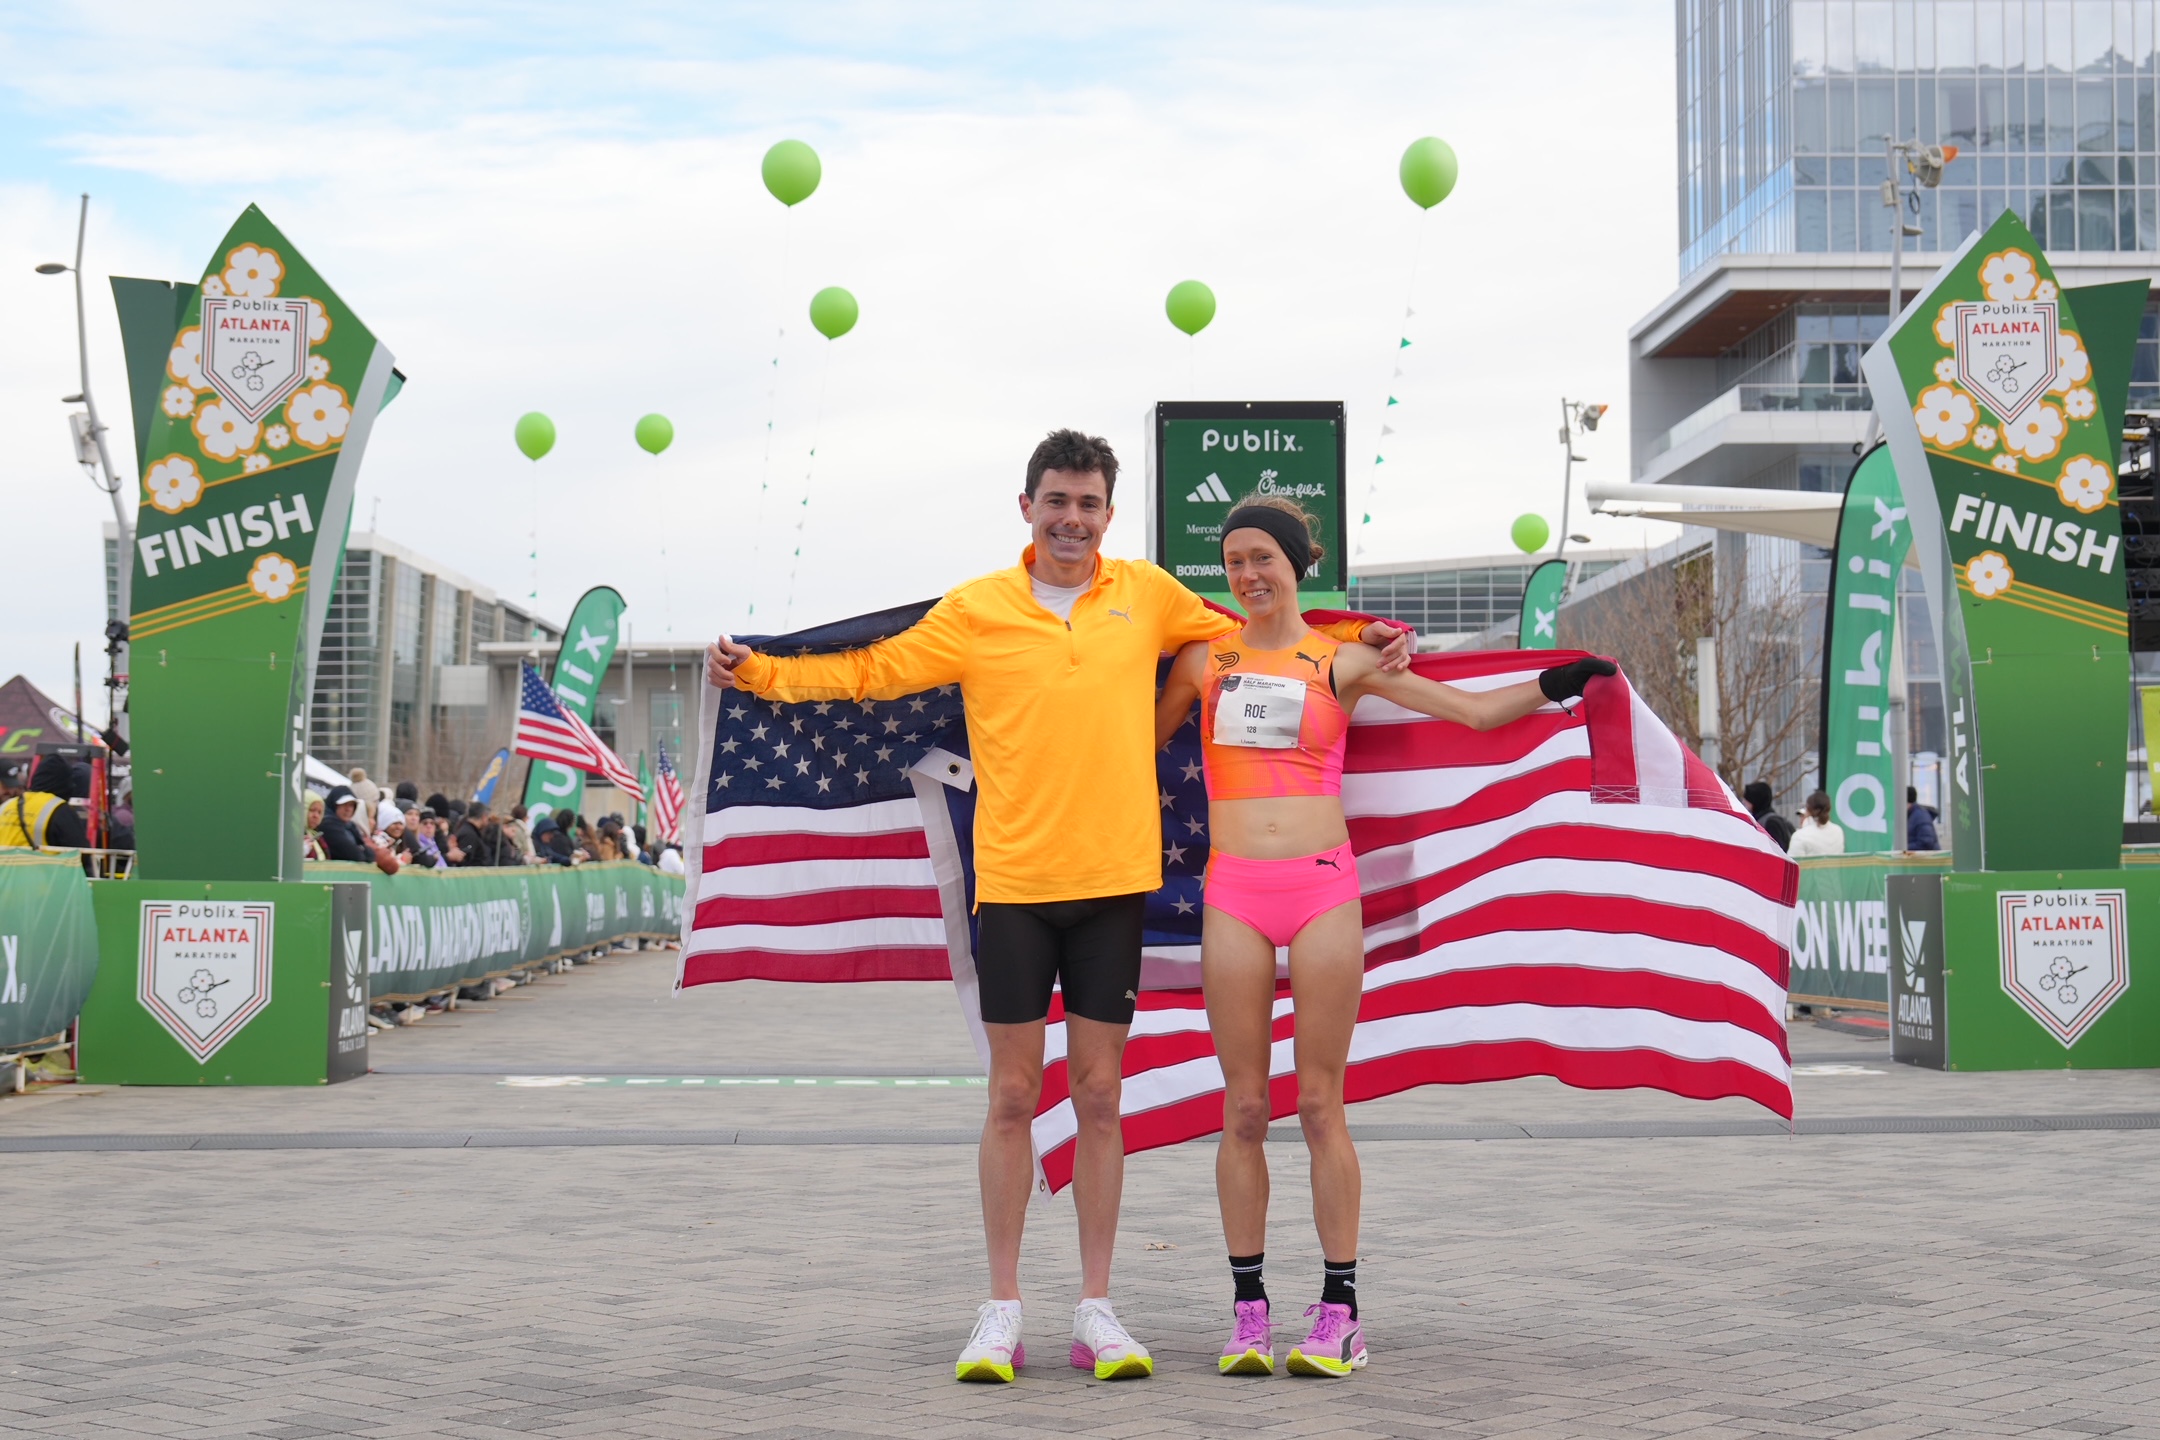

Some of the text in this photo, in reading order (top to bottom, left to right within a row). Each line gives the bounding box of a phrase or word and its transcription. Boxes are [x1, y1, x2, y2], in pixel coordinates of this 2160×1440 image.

[232, 299, 280, 312] Publix
[1982, 303, 2028, 315] Publix
[220, 317, 291, 332] ATLANTA
[1972, 321, 2040, 335] ATLANTA
[229, 337, 281, 345] MARATHON
[1982, 340, 2031, 348] MARATHON
[1202, 429, 1297, 452] Publix
[137, 493, 314, 578] FINISH
[1949, 493, 2120, 575] FINISH
[1244, 703, 1268, 719] ROE
[1246, 726, 1257, 734] 128
[2033, 894, 2088, 907] Publix
[179, 904, 236, 918] Publix
[2021, 916, 2104, 931] ATLANTA
[163, 927, 250, 943] ATLANTA
[2033, 939, 2093, 947] MARATHON
[175, 951, 237, 959] MARATHON
[1897, 993, 1932, 1026] ATLANTA
